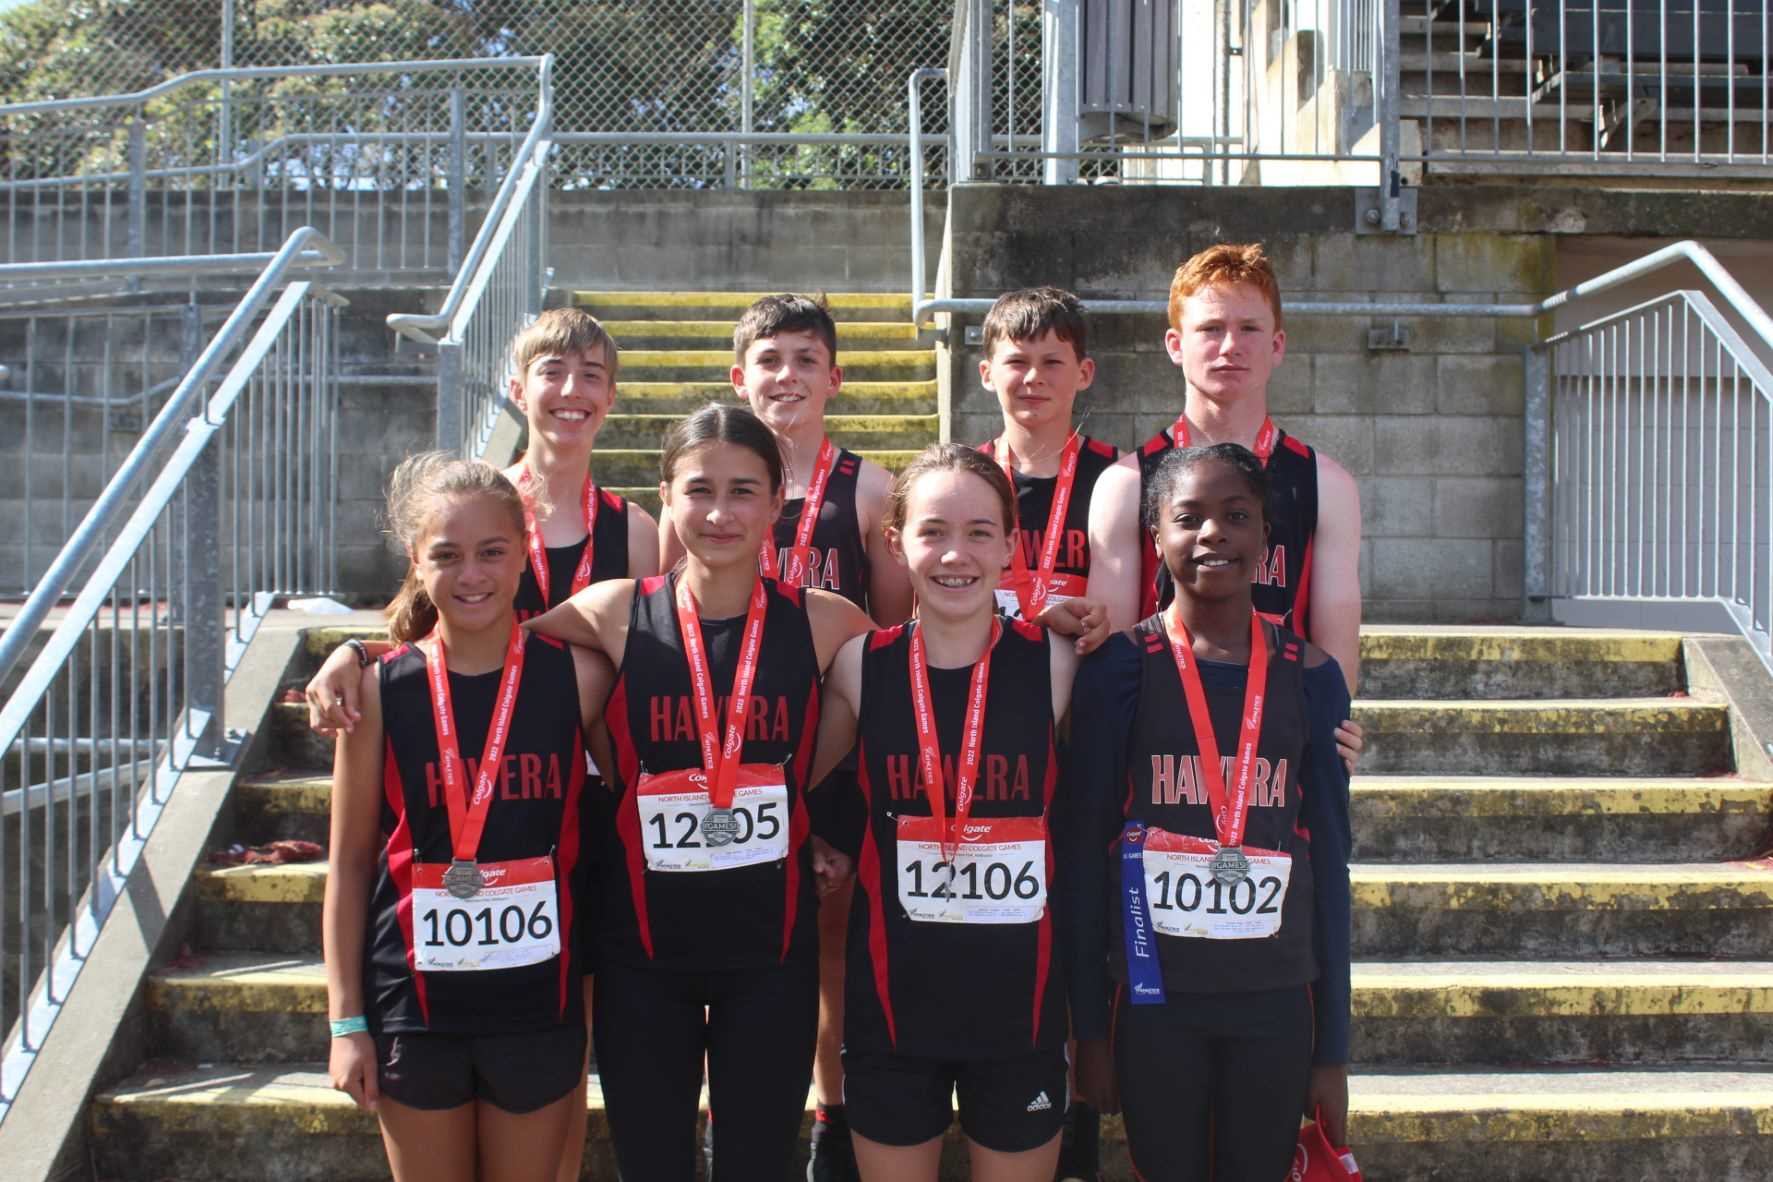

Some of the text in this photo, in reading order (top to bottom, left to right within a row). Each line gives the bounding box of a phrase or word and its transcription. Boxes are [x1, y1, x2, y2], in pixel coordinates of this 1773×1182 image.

[750, 620, 759, 637] Games
[746, 638, 755, 659] Colgate
[693, 654, 702, 672] Island
[742, 660, 751, 678] Island
[508, 665, 517, 684] Games
[696, 672, 705, 696] Colgate
[915, 669, 923, 688] Island
[502, 685, 513, 707] Colgate
[739, 679, 748, 696] North
[974, 684, 982, 708] Colgate
[917, 689, 925, 711] Colgate
[441, 715, 449, 735] Games
[498, 708, 508, 726] Island
[650, 695, 788, 742] HARA
[971, 709, 980, 728] Island
[493, 727, 503, 744] North
[724, 724, 736, 759] Colgate
[969, 729, 977, 747] North
[1243, 743, 1251, 764] Games
[425, 752, 561, 808] HERA
[886, 753, 1030, 802] HARA
[1238, 765, 1248, 789] Colgate
[473, 771, 487, 805] Colgate
[738, 789, 762, 797] GAMES
[957, 776, 967, 811] Colgate
[1236, 790, 1244, 809] Island
[649, 802, 780, 849] 1205
[951, 824, 992, 834] Clgate
[1232, 810, 1241, 829] North
[480, 867, 506, 881] gate
[905, 860, 1040, 900] 12106
[1153, 871, 1282, 915] 10102
[423, 900, 553, 947] 10106
[1129, 887, 1150, 958] Finalist
